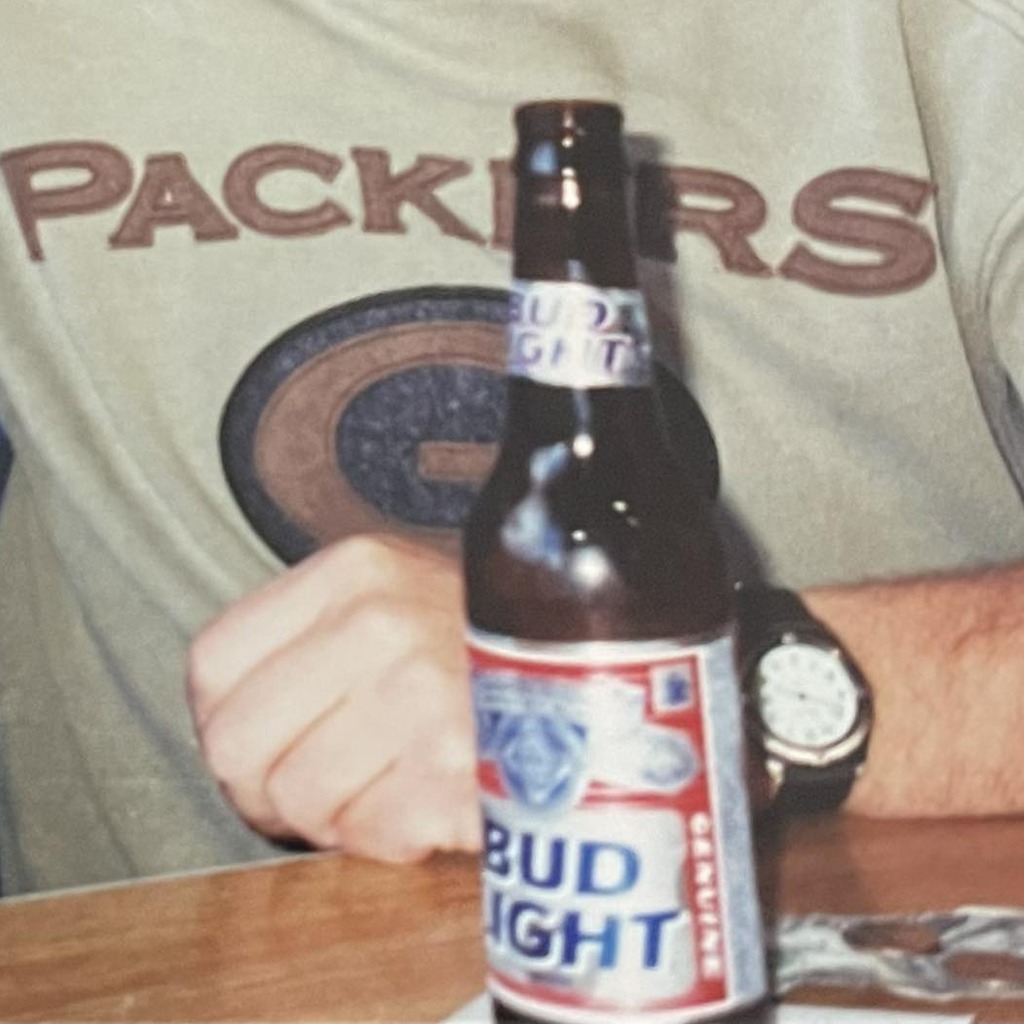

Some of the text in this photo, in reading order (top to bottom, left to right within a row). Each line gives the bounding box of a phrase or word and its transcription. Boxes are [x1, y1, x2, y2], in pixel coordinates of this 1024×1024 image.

[484, 820, 639, 894] BUD
[690, 811, 723, 977] GENUINE
[489, 892, 682, 967] IGHT
